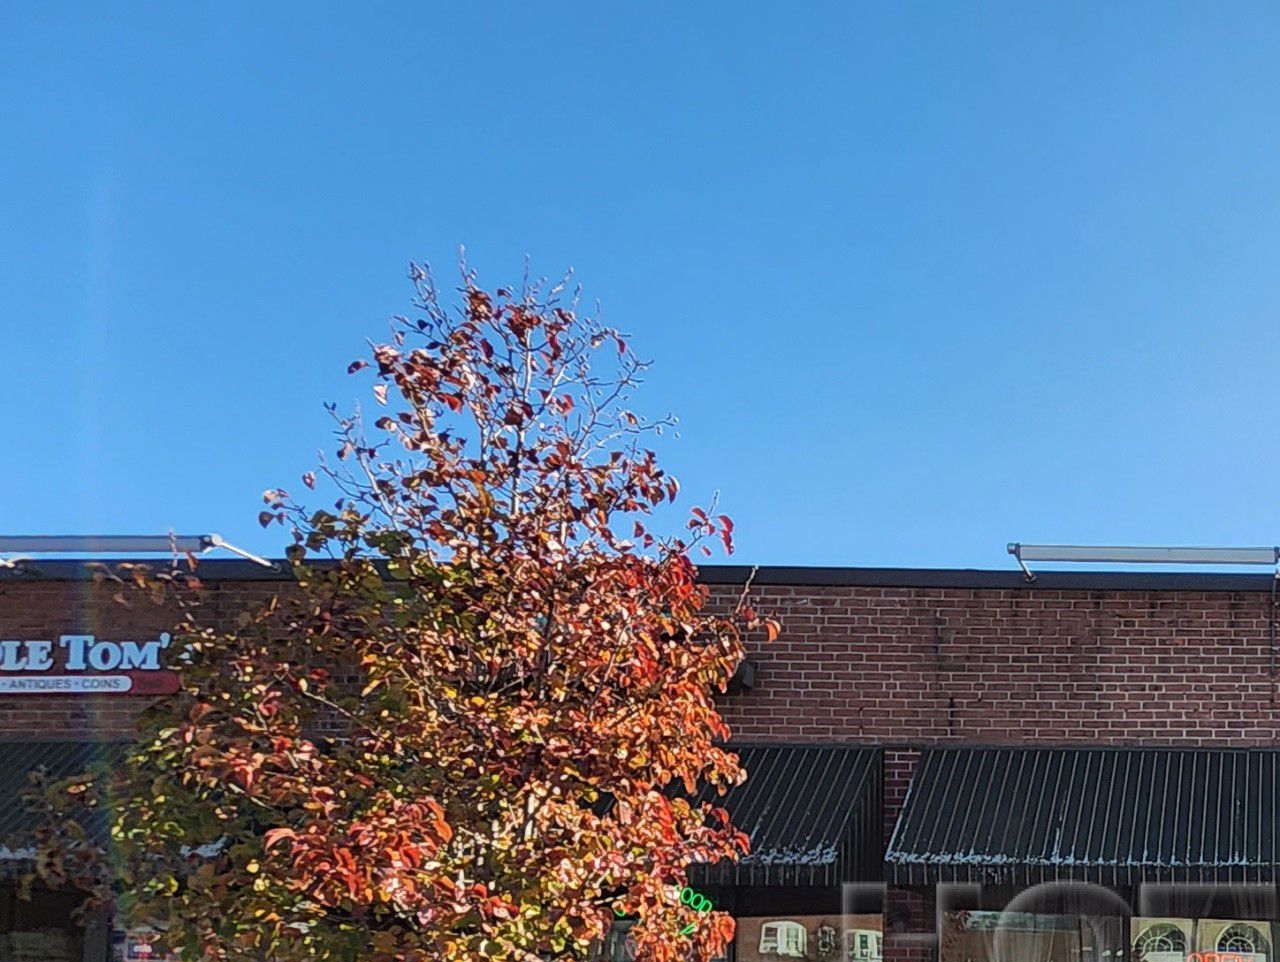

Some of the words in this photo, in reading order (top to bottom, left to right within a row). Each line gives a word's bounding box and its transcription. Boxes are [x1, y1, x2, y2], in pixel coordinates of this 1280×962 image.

[0, 640, 54, 671] LE
[59, 632, 193, 671] TOM'
[9, 679, 72, 690] ANTIQUES
[81, 678, 121, 689] COINS
